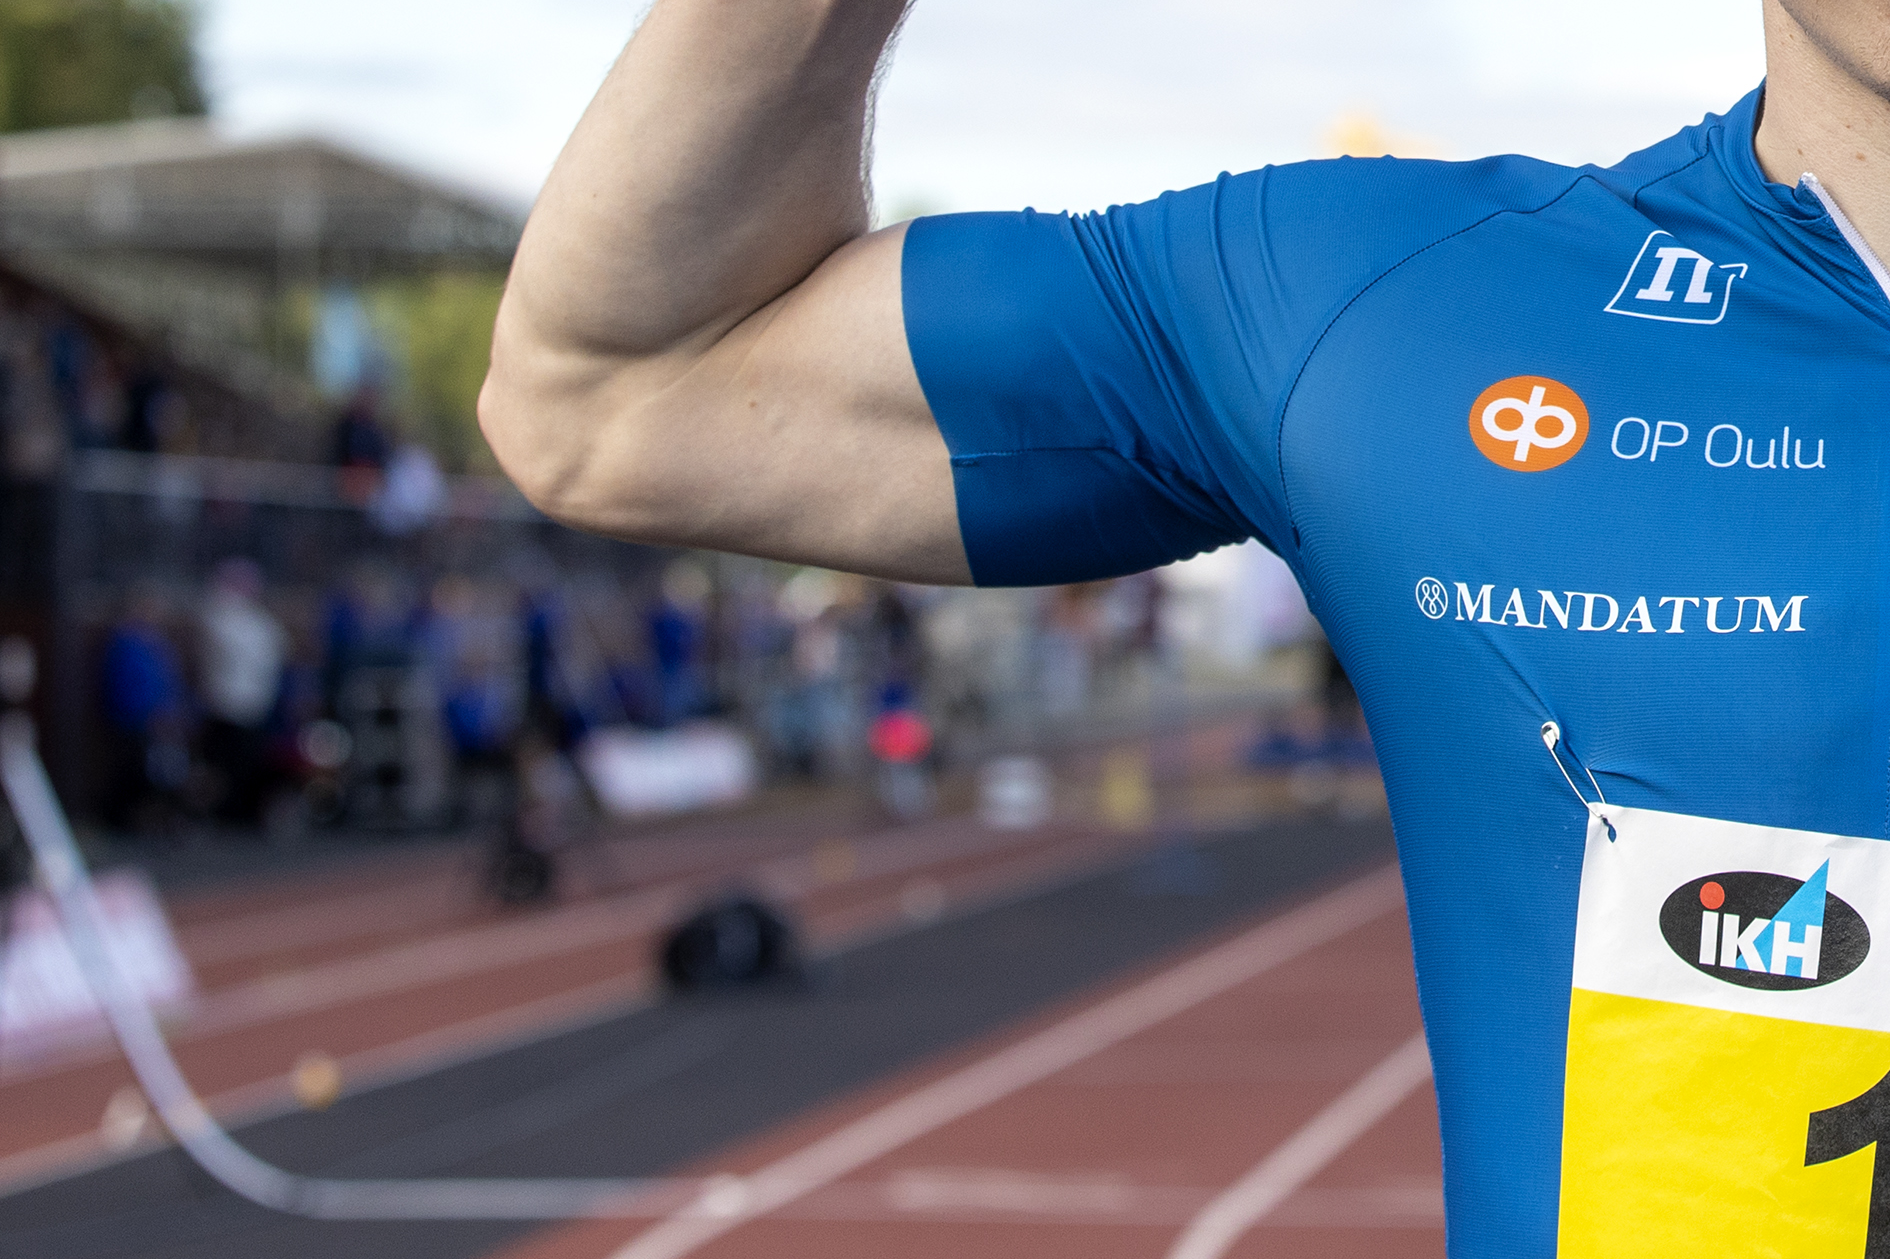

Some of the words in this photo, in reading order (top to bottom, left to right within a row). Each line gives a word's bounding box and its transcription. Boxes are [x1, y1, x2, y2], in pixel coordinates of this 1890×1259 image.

[1611, 416, 1689, 462] OP
[1704, 423, 1826, 469] Oulu
[1453, 581, 1809, 634] MANDATUM
